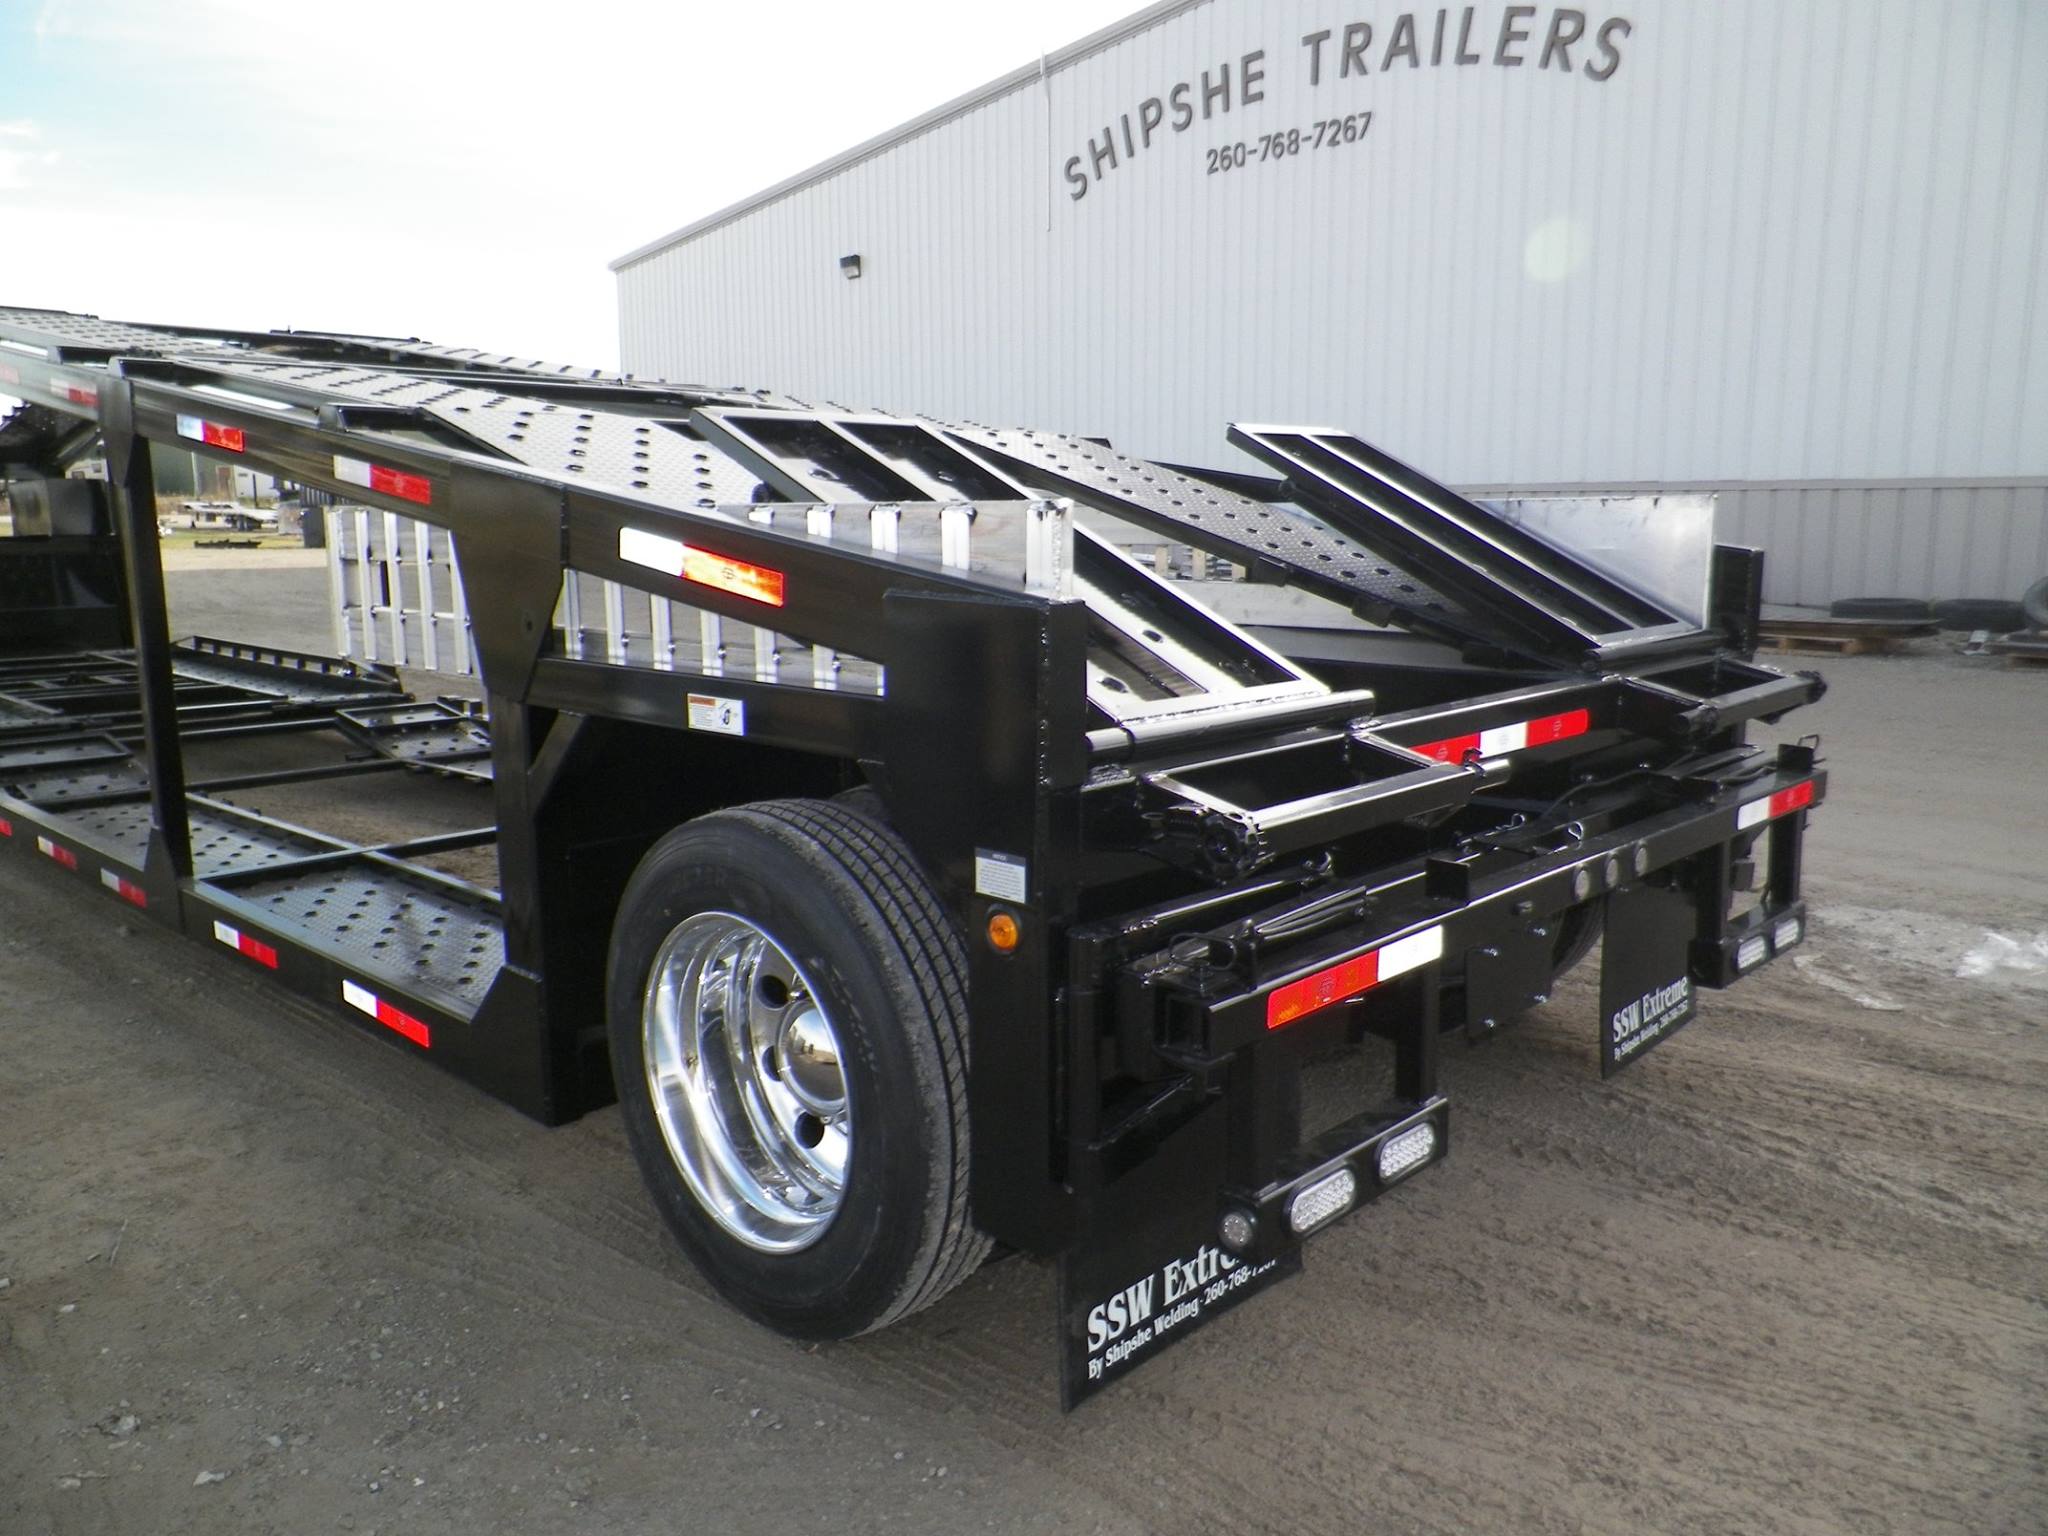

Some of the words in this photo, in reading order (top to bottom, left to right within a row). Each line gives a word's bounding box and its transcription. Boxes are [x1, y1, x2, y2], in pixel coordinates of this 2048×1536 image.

[1063, 49, 1266, 200] SHIPSHE
[1302, 6, 1632, 85] TRAILERS
[1206, 111, 1373, 175] 260-768-7267
[1612, 1000, 1640, 1042] SSW
[1642, 976, 1688, 1024] Extreme
[1088, 1273, 1155, 1353] SSW
[1163, 1244, 1240, 1306] Extre
[1088, 1356, 1103, 1380] By
[1105, 1327, 1151, 1367] Shipshe
[1154, 1297, 1199, 1337] Welding
